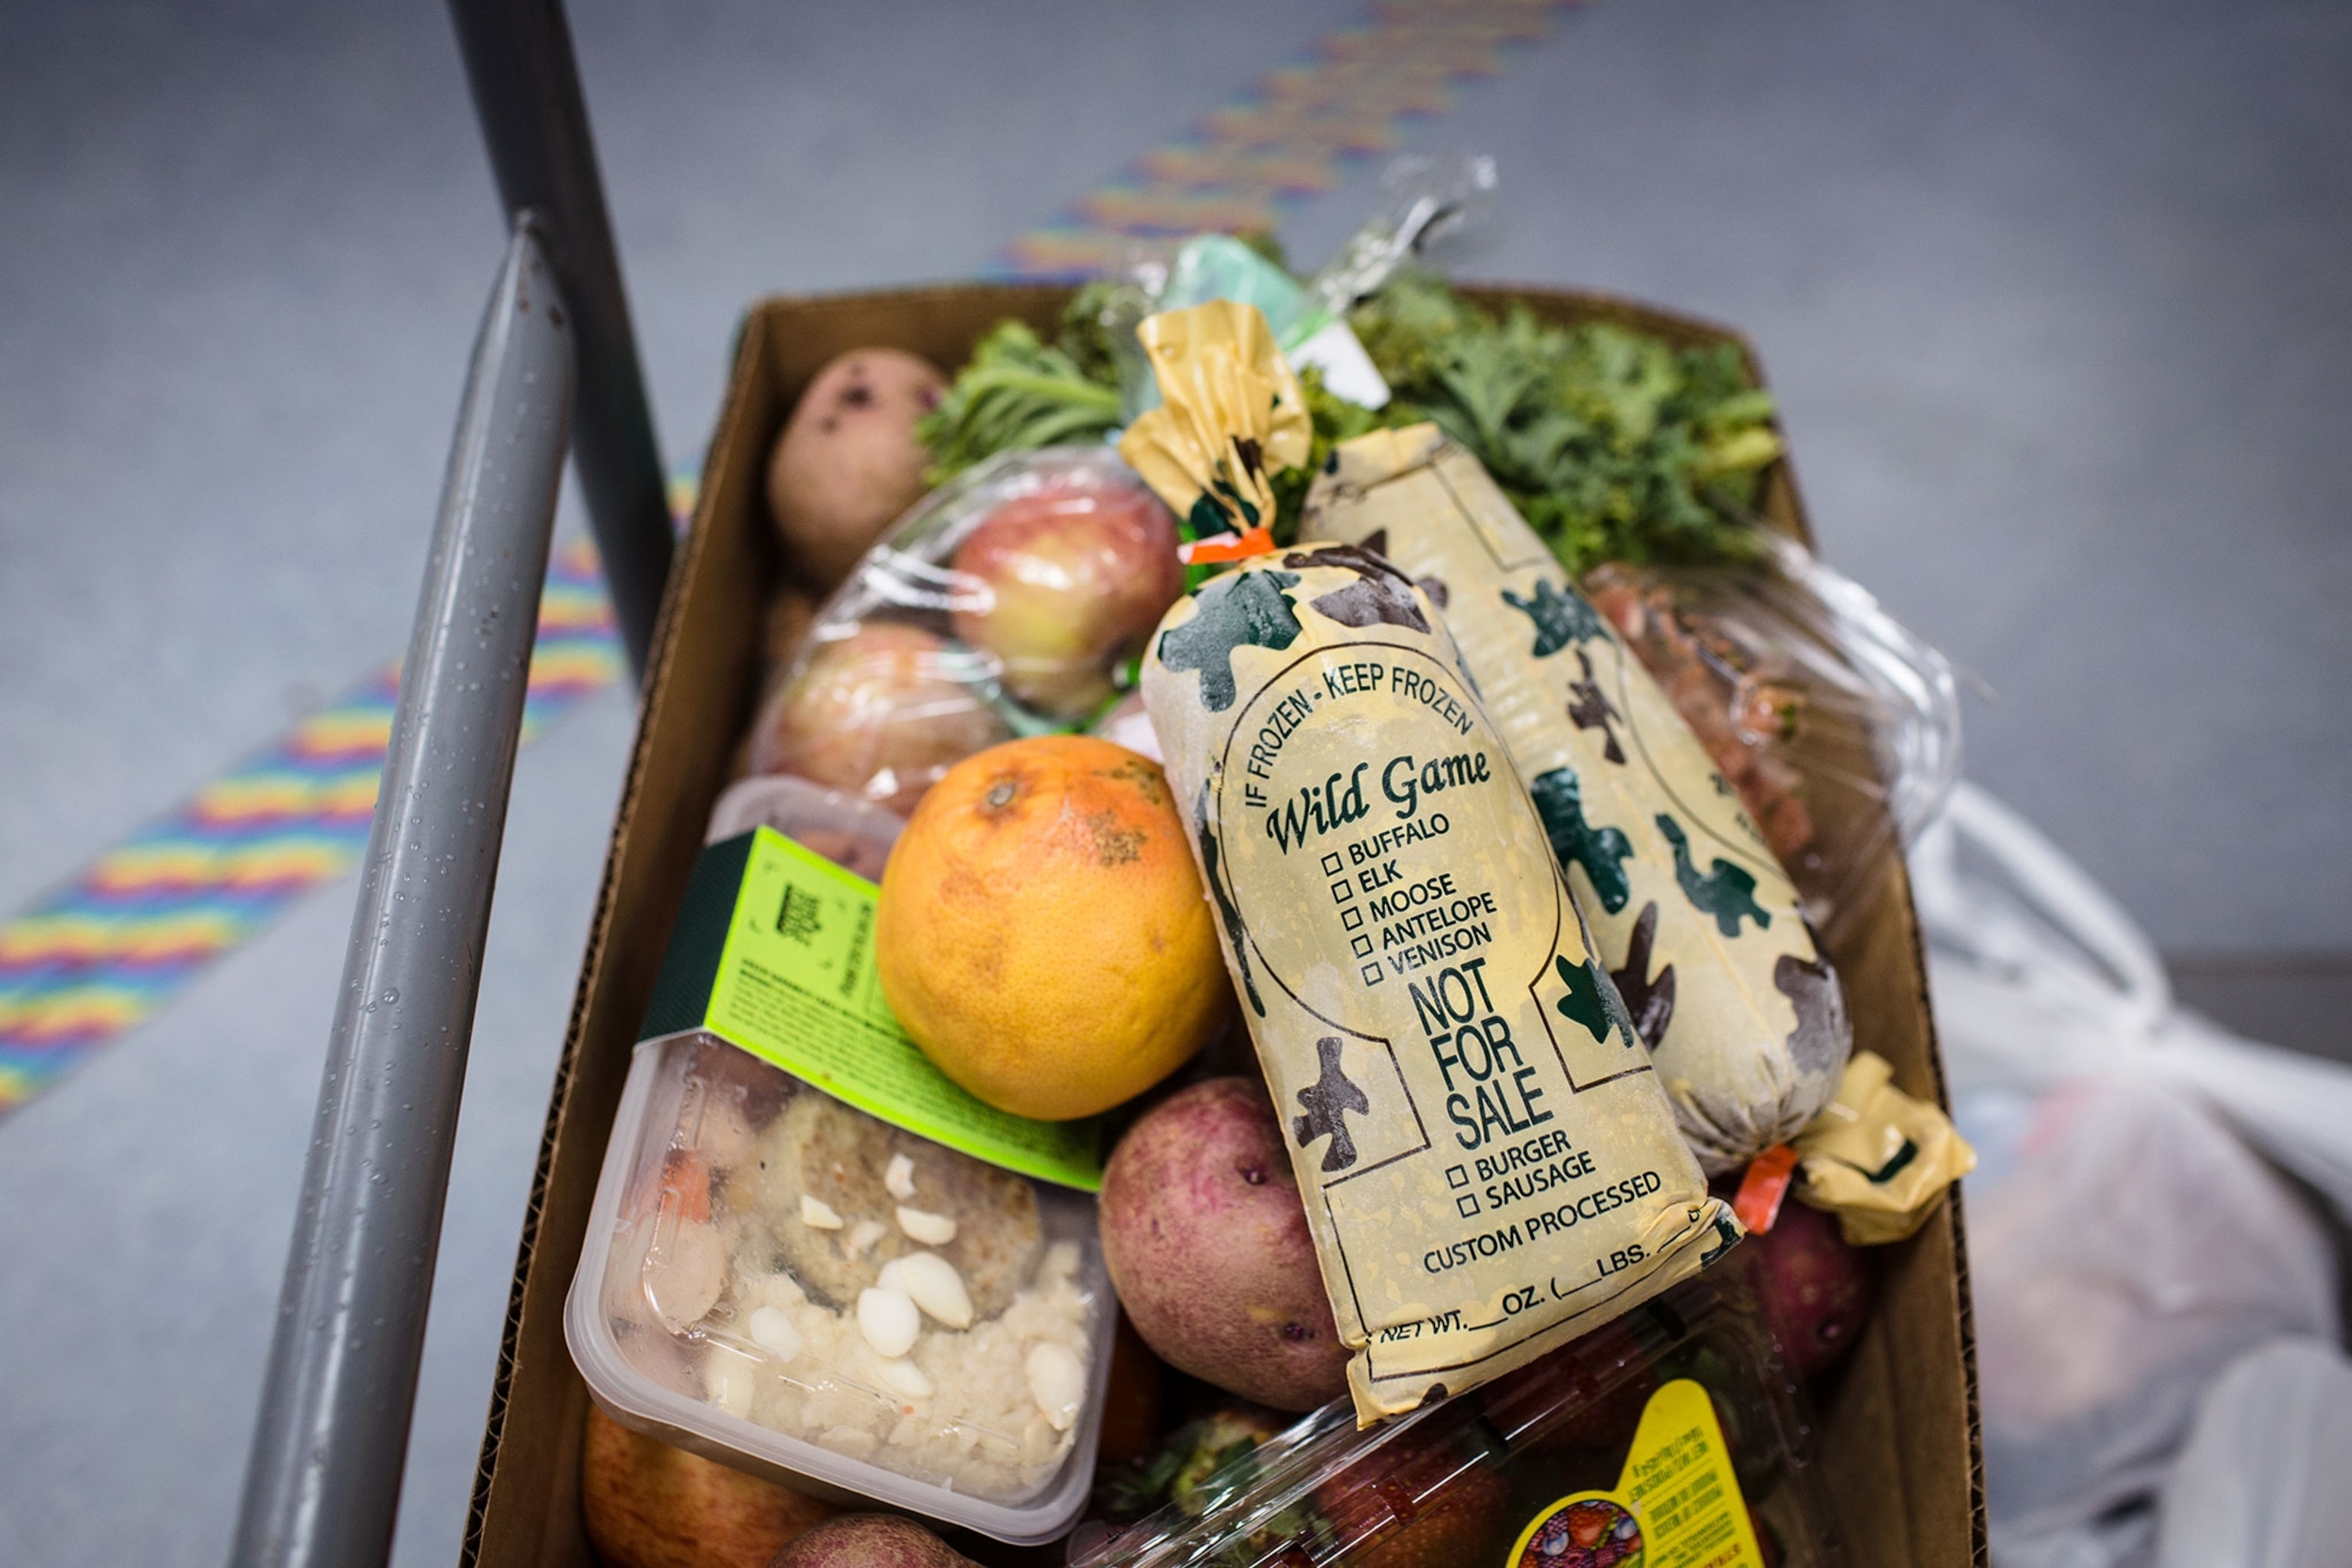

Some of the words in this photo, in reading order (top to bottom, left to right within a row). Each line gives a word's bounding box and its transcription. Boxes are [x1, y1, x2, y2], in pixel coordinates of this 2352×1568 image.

[1322, 663, 1383, 700] KEEP
[1392, 667, 1473, 735] FROZEN
[1248, 689, 1313, 779] FROZEN
[1246, 783, 1266, 808] IF
[1266, 763, 1370, 855] Wild
[1382, 752, 1491, 819] Game
[1348, 813, 1449, 866] BUFFALO
[1358, 860, 1403, 893] ELK
[1369, 874, 1456, 922] MOOSE
[1383, 892, 1497, 949] ANTELOPE
[1388, 923, 1491, 975] VENISON
[1409, 958, 1494, 1035] NOT
[1429, 1015, 1523, 1091] FOR
[1446, 1067, 1553, 1150] SALE
[1475, 1130, 1572, 1182] BURGER
[1486, 1152, 1596, 1210] SAUSAGE
[1424, 1226, 1523, 1273] CUSTOM
[1526, 1171, 1661, 1241] PROCESSED
[1380, 1321, 1424, 1343] NET
